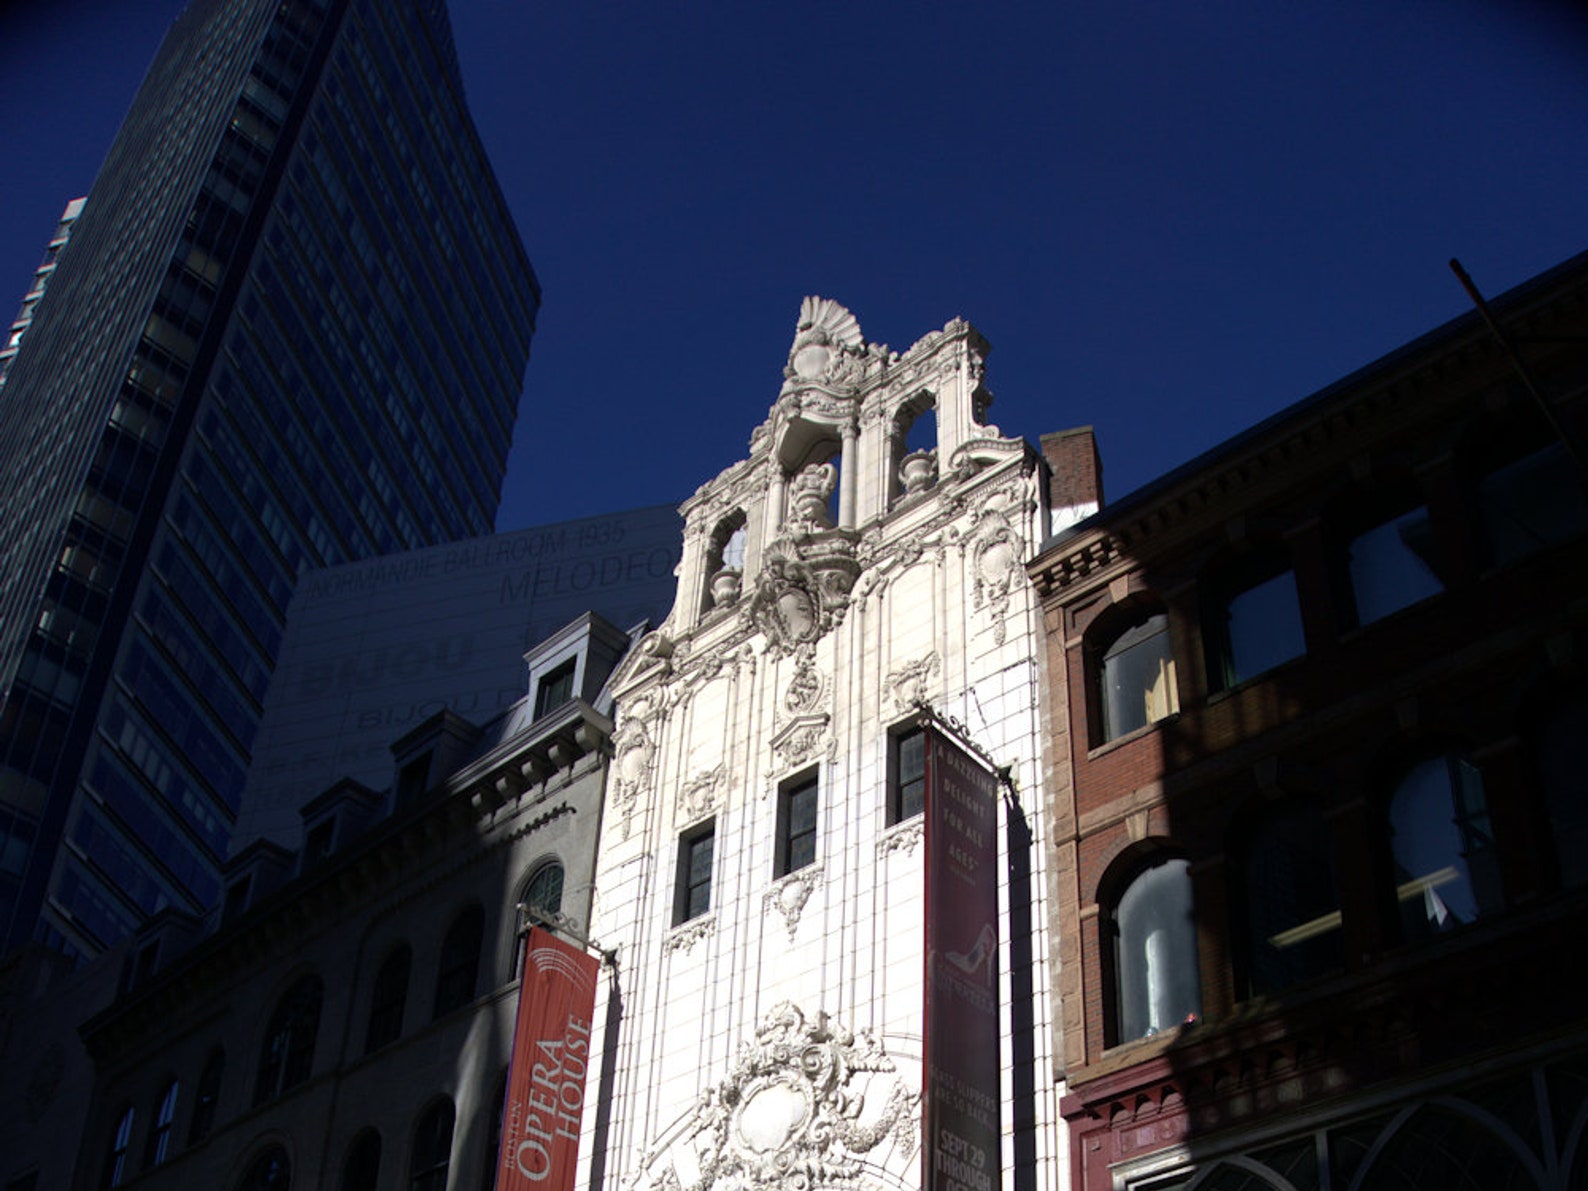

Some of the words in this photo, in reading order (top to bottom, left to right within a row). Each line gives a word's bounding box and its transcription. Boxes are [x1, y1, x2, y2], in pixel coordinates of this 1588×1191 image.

[445, 531, 569, 573] BALLROOM
[517, 1038, 565, 1182] OPERA
[556, 1013, 592, 1142] HOUSE
[941, 1129, 969, 1162] SEPT
[970, 1144, 986, 1169] 29
